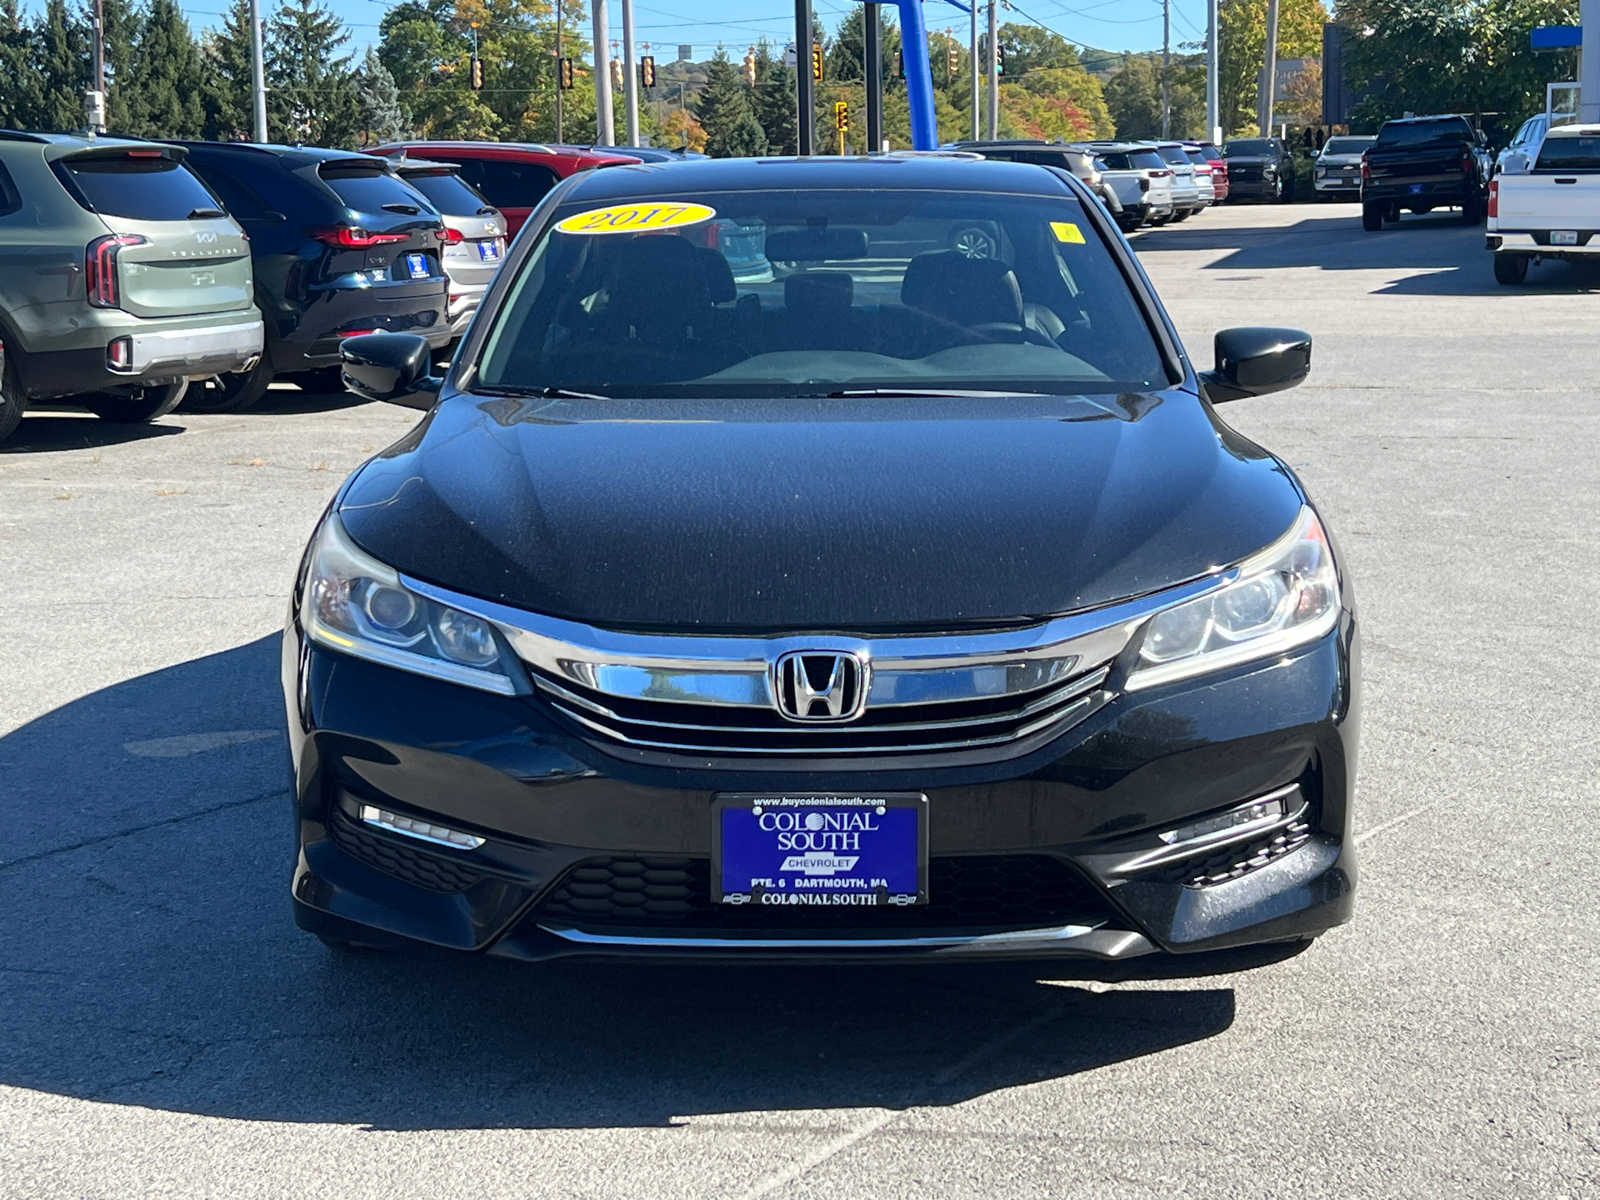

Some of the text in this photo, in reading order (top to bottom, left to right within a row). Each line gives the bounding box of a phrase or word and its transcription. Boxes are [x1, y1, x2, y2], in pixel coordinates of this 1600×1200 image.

[580, 206, 689, 230] 2017
[753, 797, 886, 807] www.buycolonialsouth.com
[759, 812, 880, 832] COLONIAL
[777, 832, 860, 851] SOUTH
[788, 858, 852, 868] CHEVROLET
[778, 878, 786, 888] 6
[794, 878, 868, 890] DARTMOUTH,
[870, 878, 889, 888] MA
[761, 893, 878, 906] COLONIAL SOUTH
